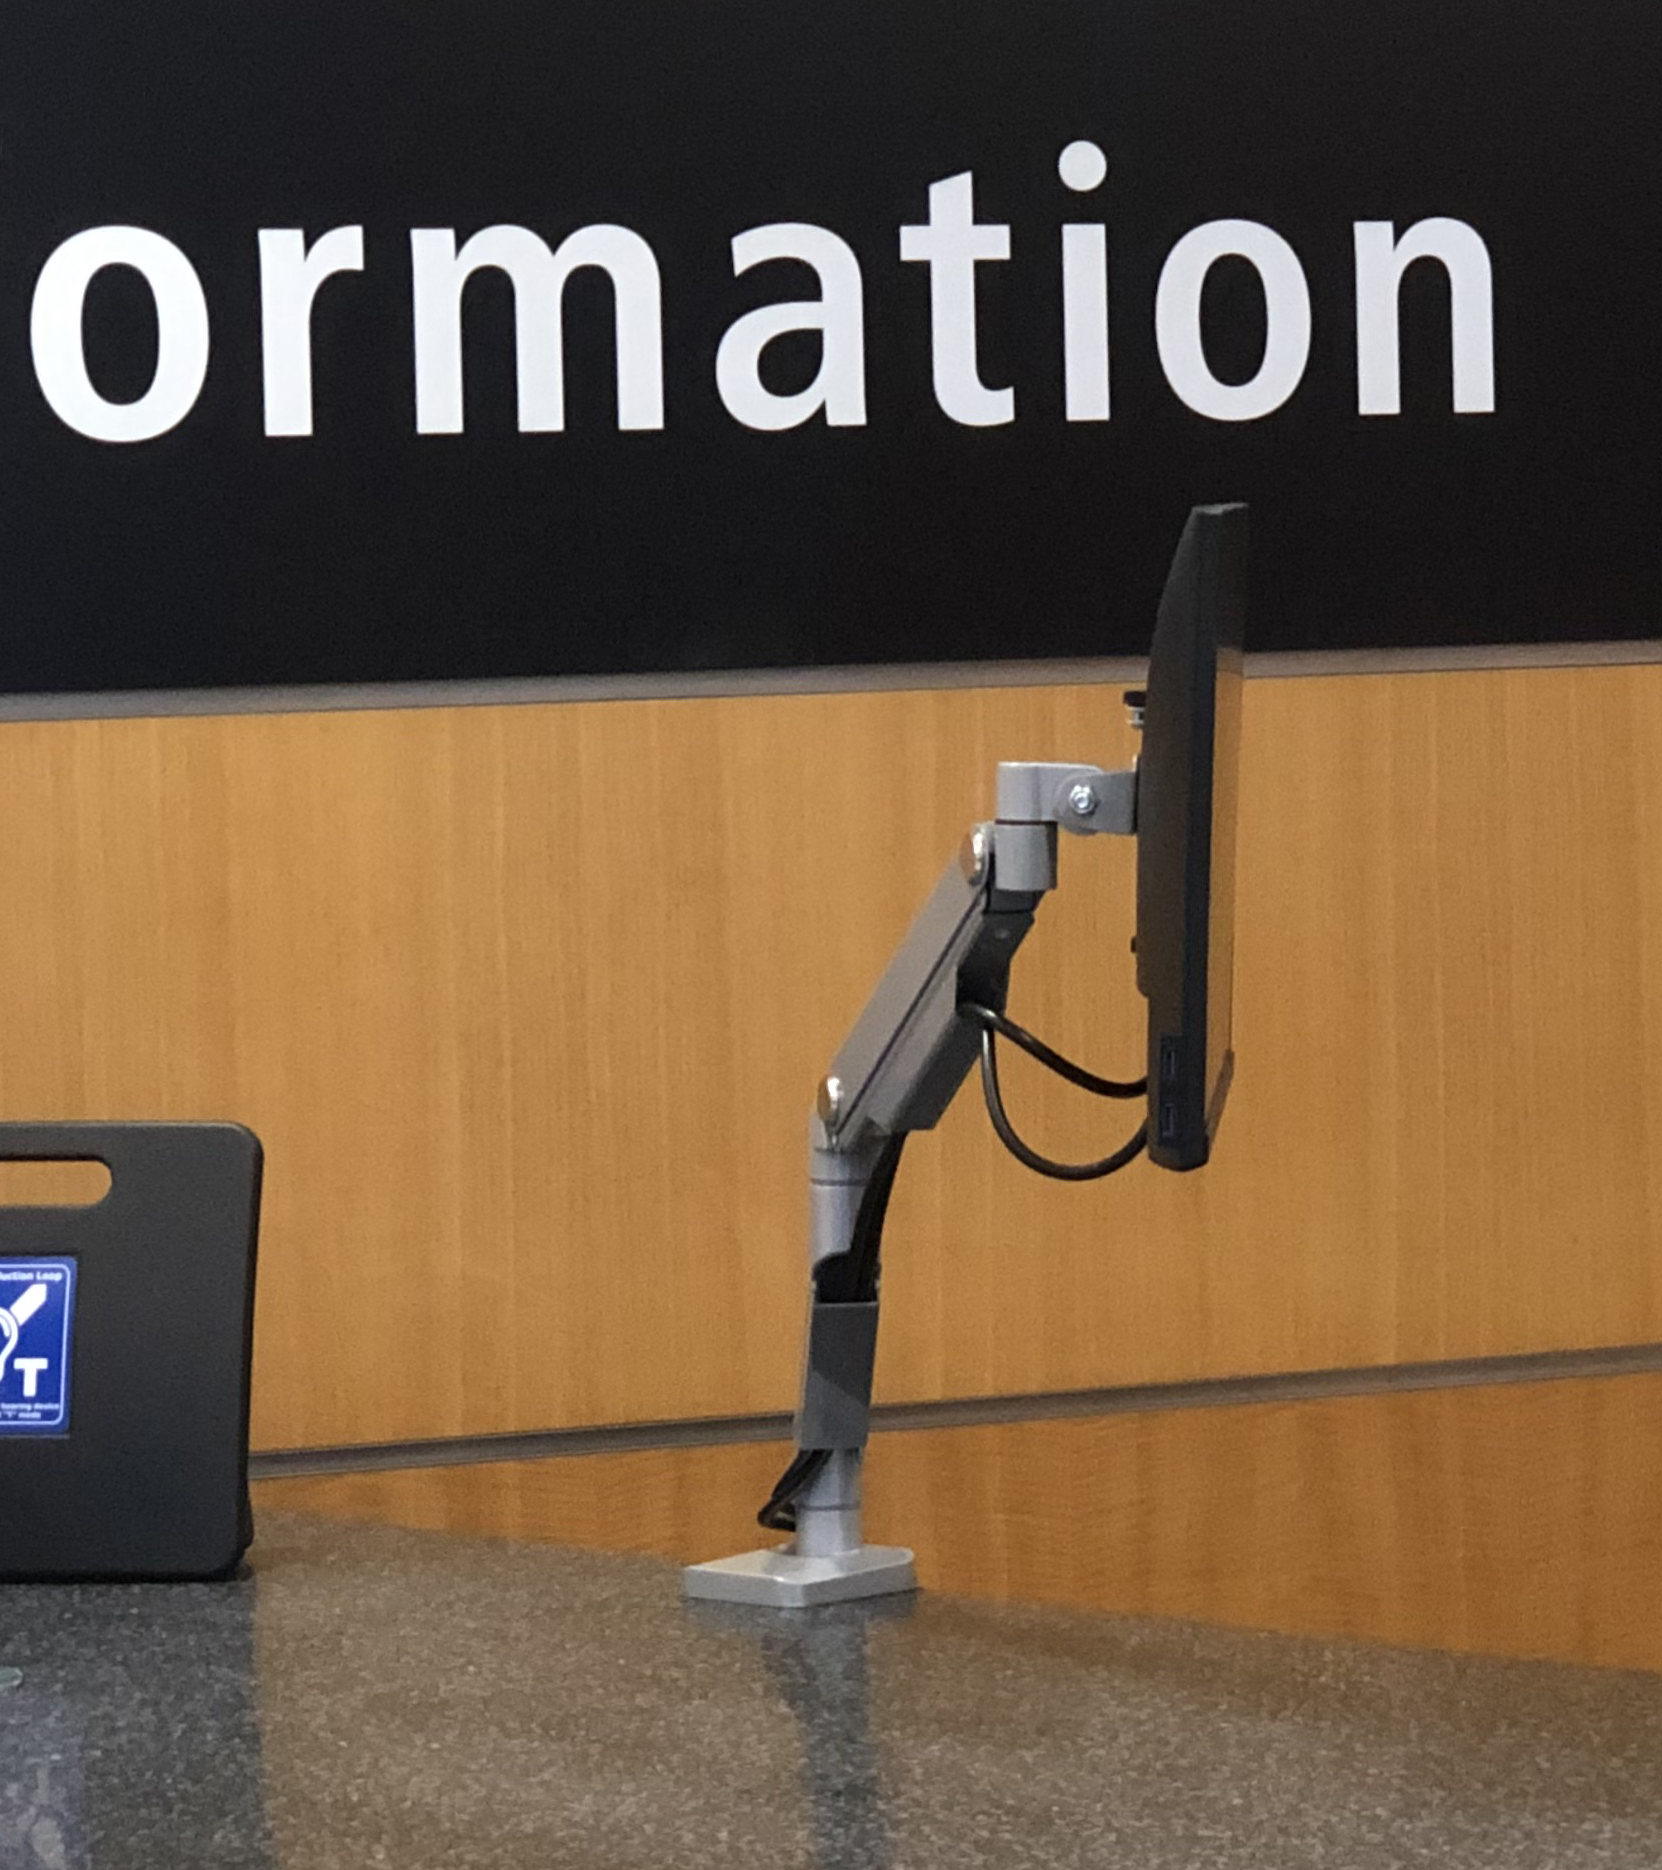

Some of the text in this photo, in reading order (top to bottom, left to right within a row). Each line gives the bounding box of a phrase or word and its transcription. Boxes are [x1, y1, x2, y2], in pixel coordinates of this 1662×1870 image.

[29, 140, 1496, 443] ormation
[36, 1271, 62, 1283] Loop
[13, 1357, 48, 1397] T
